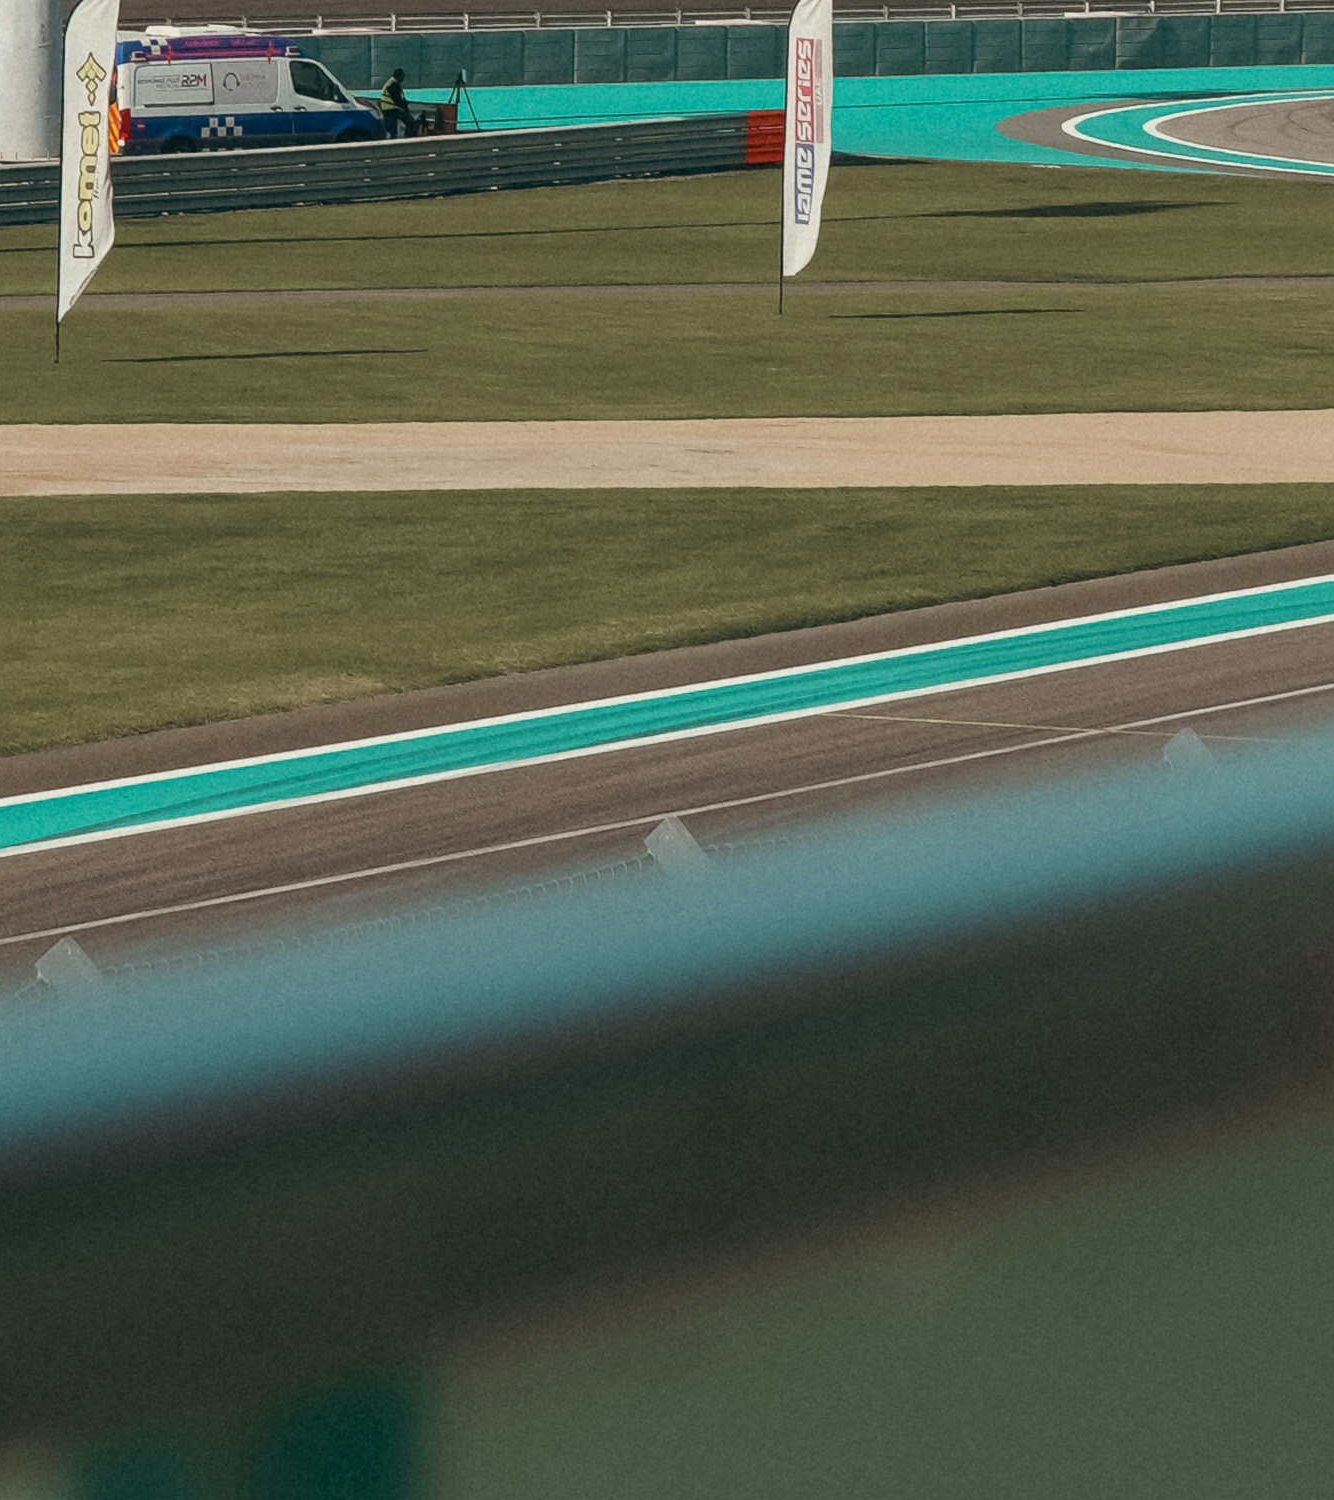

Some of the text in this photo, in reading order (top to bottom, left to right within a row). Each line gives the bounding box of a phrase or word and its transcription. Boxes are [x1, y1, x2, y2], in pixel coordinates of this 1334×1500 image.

[181, 74, 207, 87] RPM
[796, 38, 813, 141] series
[73, 112, 101, 258] komet
